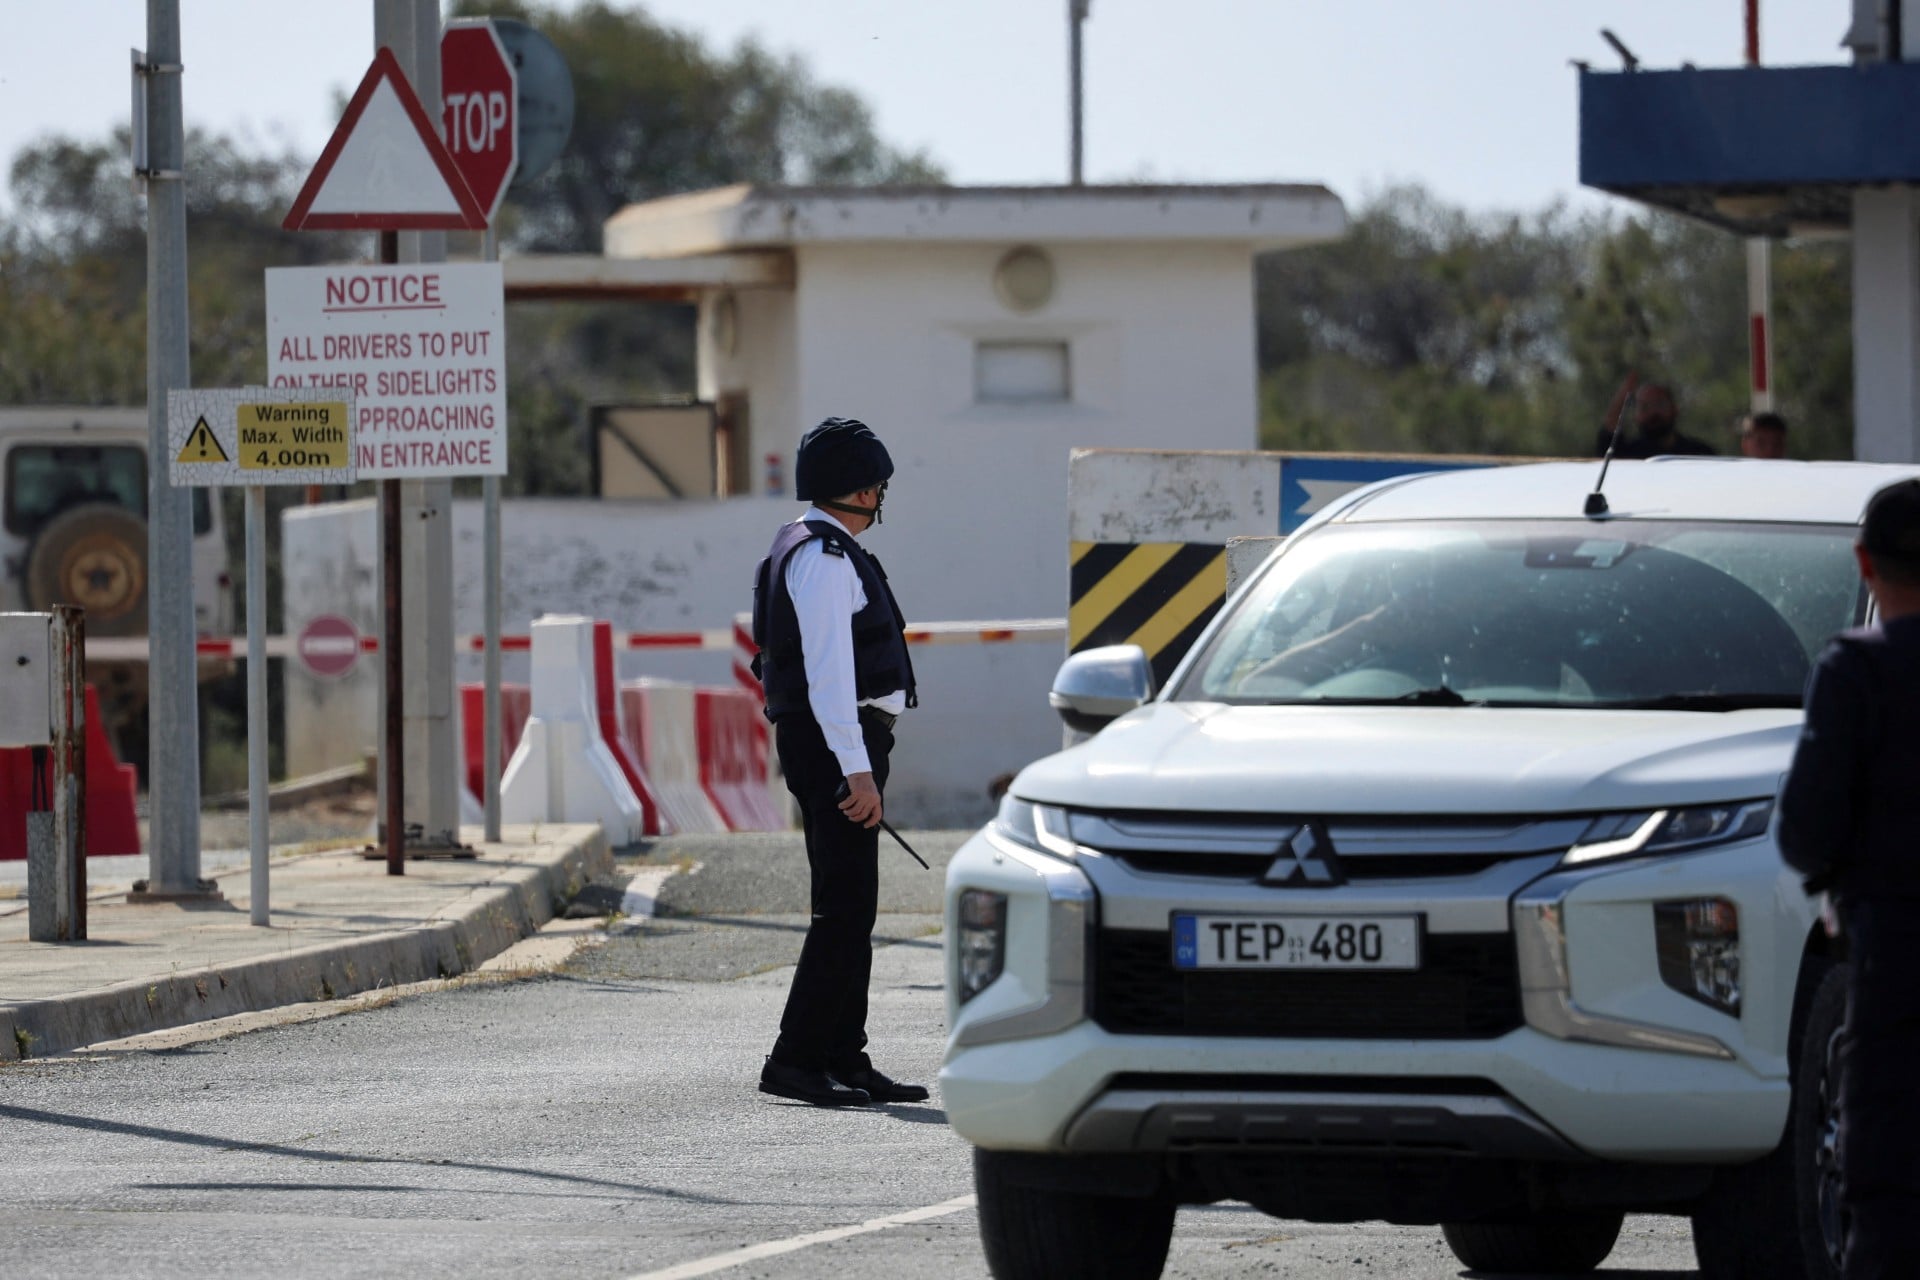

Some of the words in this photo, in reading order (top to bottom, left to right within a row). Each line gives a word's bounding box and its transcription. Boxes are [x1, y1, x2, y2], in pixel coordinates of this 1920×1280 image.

[326, 275, 441, 305] NOTICE
[279, 336, 318, 362] ALL
[323, 333, 412, 361] DRIVERS
[418, 332, 446, 357] TO
[451, 331, 491, 356] PUT
[377, 368, 497, 397] SIDELIGHTS
[256, 406, 329, 424] Warning
[357, 405, 495, 433] PPROACHING
[242, 429, 283, 445] Max.
[293, 427, 343, 444] Width
[256, 450, 330, 467] 4.00m
[380, 440, 492, 469] ENTRANCE
[1209, 922, 1285, 962] TEP
[1309, 922, 1383, 962] 480
